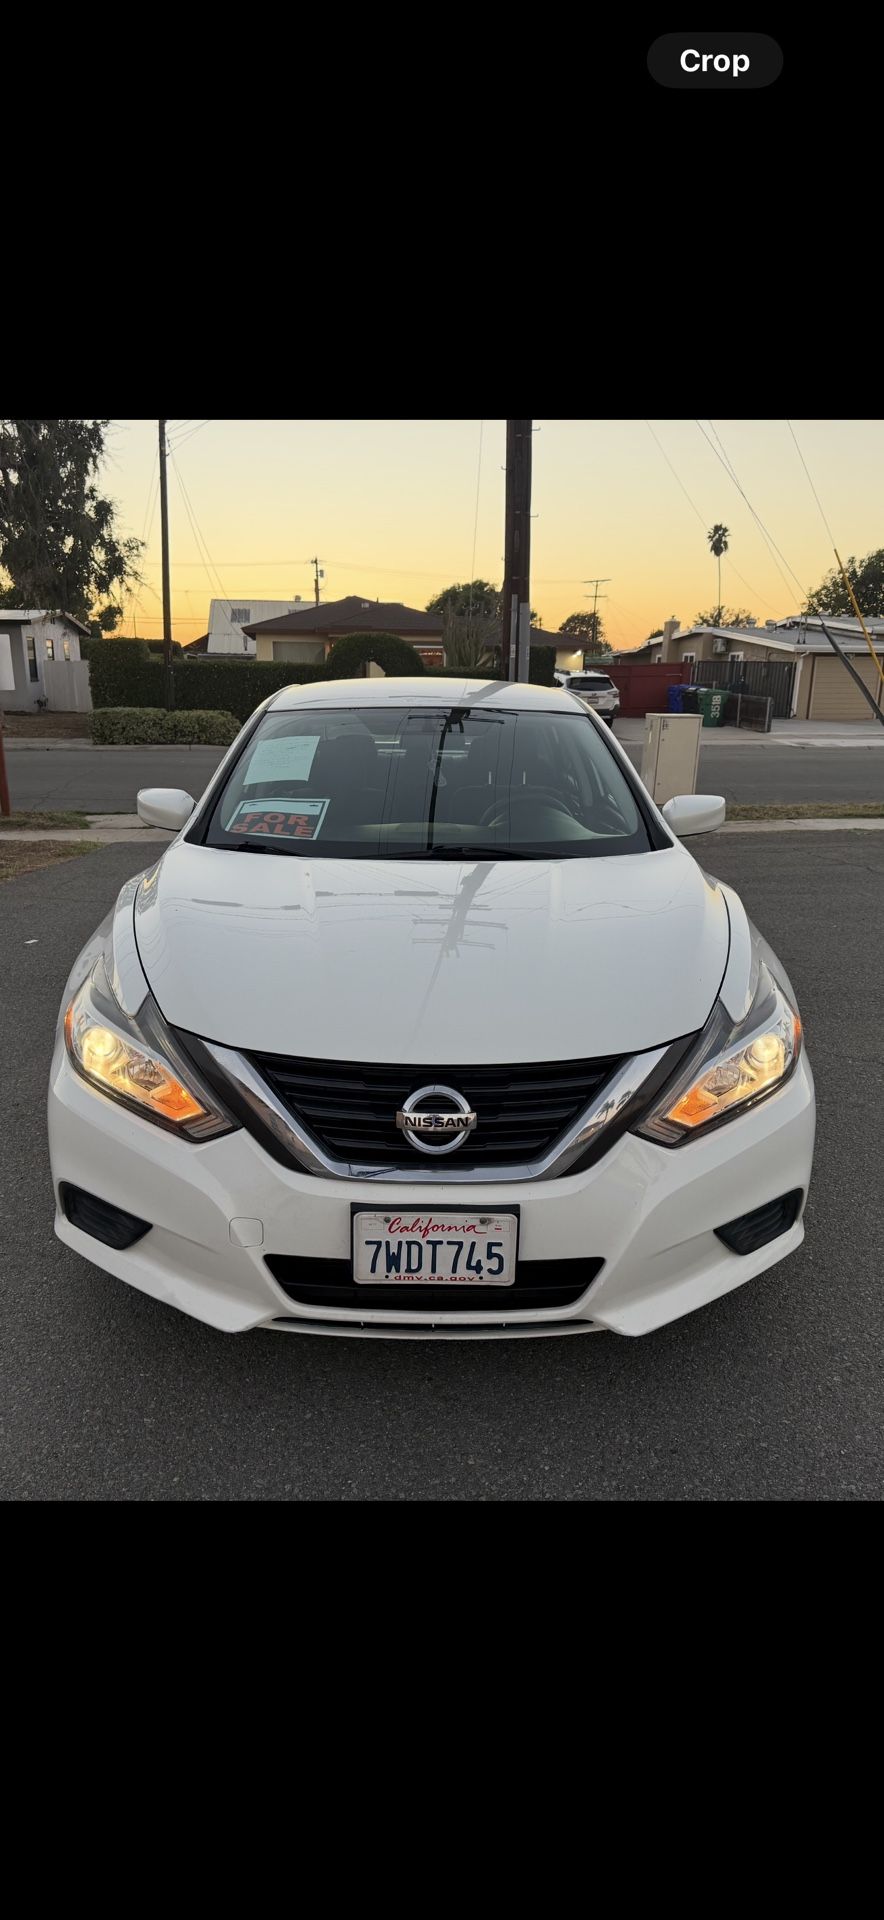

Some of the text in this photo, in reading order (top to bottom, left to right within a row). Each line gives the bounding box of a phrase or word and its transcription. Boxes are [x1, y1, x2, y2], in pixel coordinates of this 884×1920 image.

[245, 812, 309, 825] FOR
[231, 823, 313, 837] SALE
[404, 1116, 469, 1127] NISSAN
[388, 1217, 487, 1238] California
[364, 1240, 504, 1275] 7WDT745
